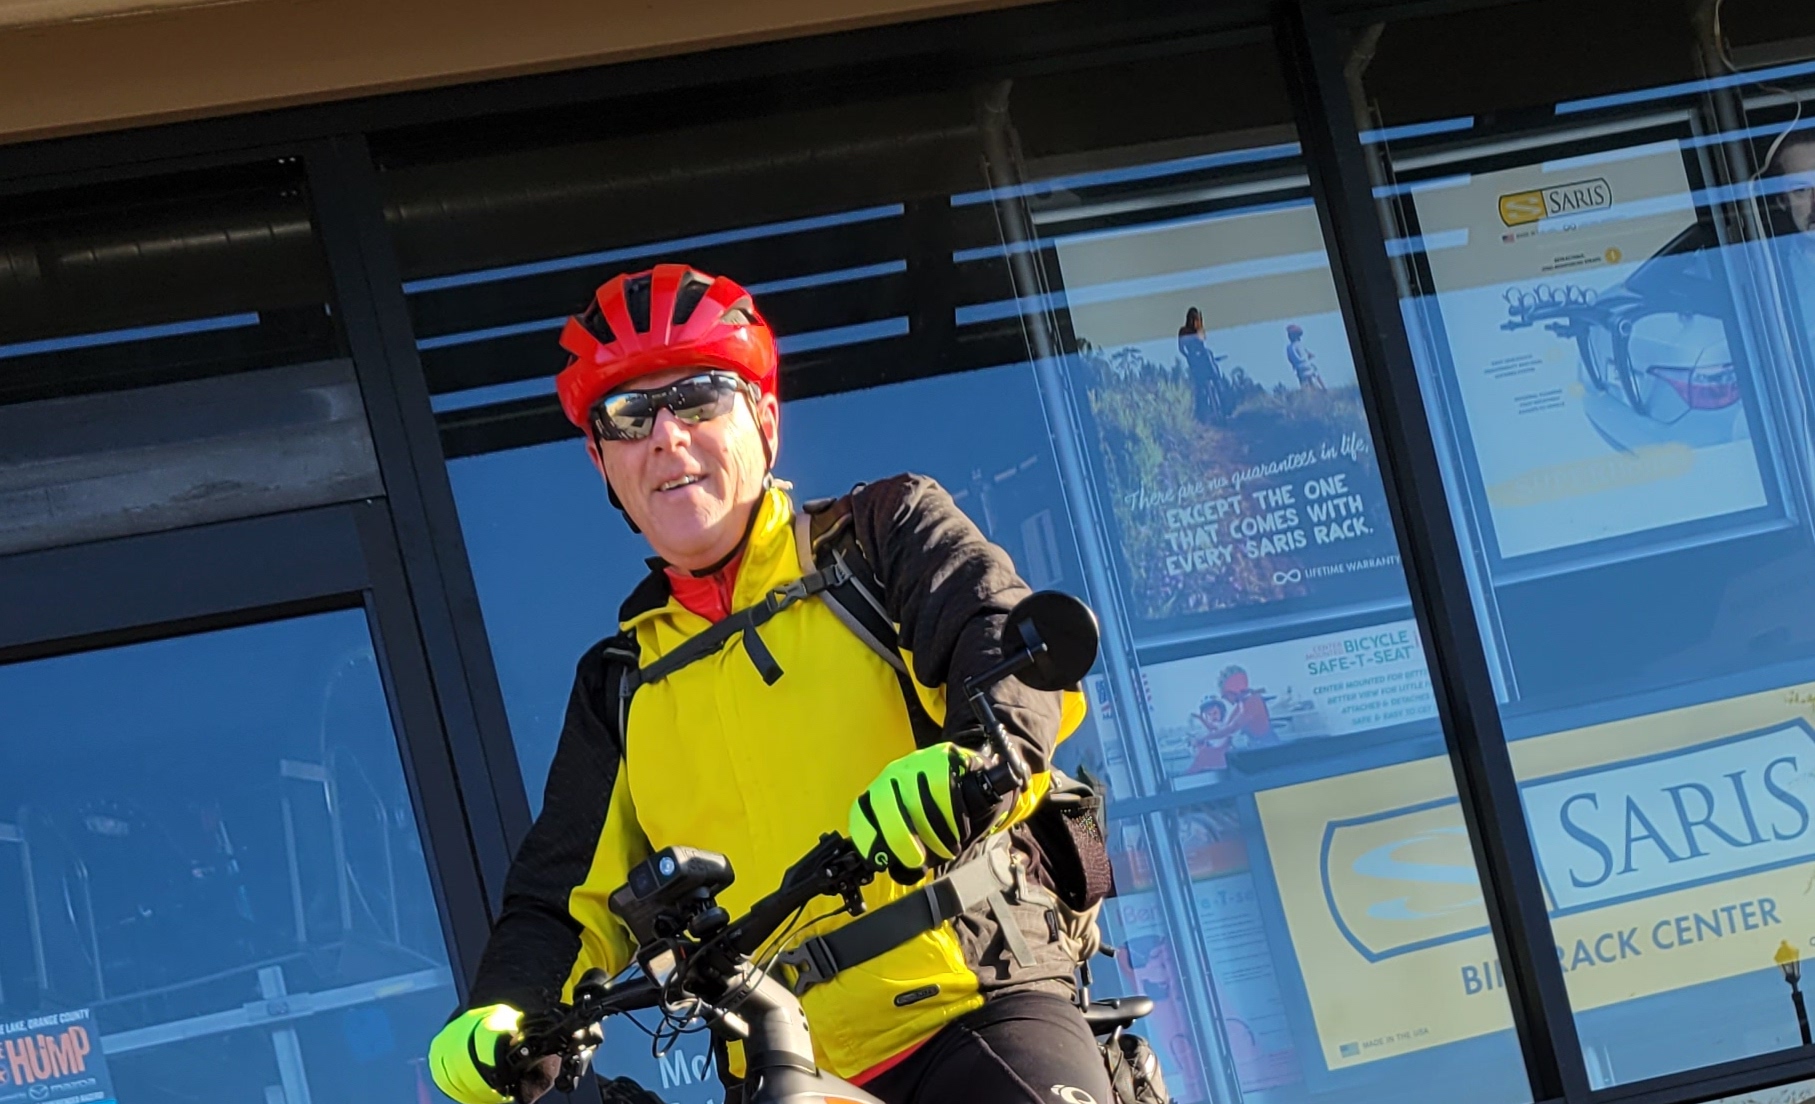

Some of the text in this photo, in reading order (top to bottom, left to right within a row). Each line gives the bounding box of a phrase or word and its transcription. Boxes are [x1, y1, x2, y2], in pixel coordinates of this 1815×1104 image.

[1549, 185, 1605, 214] SARIS
[1125, 431, 1370, 512] There are no guarantees in life,
[1166, 474, 1349, 529] EXCEPT THE ONE
[1165, 494, 1363, 552] THAT COMES WITH
[1166, 517, 1374, 576] EVERY SARIS RACK.
[1305, 555, 1401, 579] LIFETIME WARRANTY
[1343, 630, 1410, 653] BICYCLE
[1307, 645, 1413, 675] SAFE-T-SEAT
[1313, 683, 1344, 695] CENTER
[1346, 676, 1386, 690] MOUNTED
[1387, 673, 1403, 681] FOR
[1327, 694, 1358, 705] BETTER
[1359, 690, 1379, 700] VIEW
[1381, 686, 1398, 696] FOR
[1399, 681, 1424, 692] LITTLE
[1559, 756, 1811, 888] SARIS
[1651, 898, 1782, 950] CENTER
[27, 1014, 59, 1030] ORANGE
[60, 1008, 90, 1023] COUNTY
[1362, 1027, 1429, 1049] MADE IN THE USA
[4, 1025, 90, 1086] HUMP
